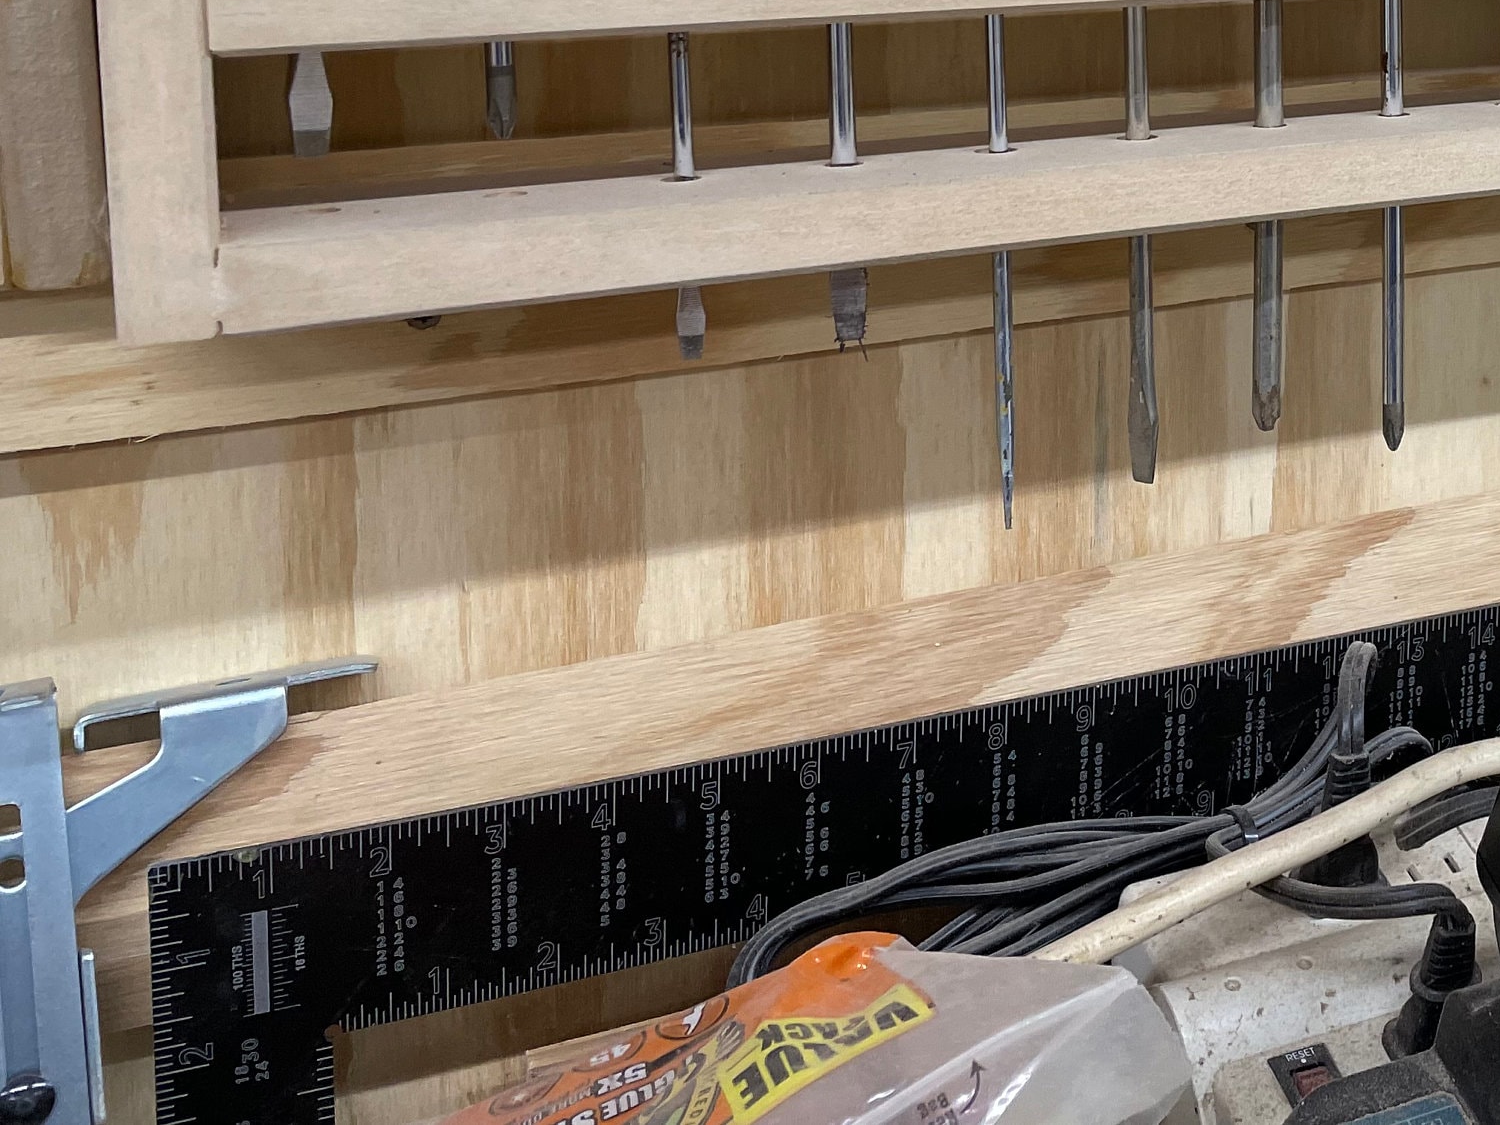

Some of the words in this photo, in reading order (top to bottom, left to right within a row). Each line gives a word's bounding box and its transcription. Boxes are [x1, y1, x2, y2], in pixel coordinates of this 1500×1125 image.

[1468, 622, 1495, 649] 14
[1397, 636, 1425, 664] 13
[1245, 667, 1273, 696] 11
[1164, 683, 1197, 712] 10
[1076, 705, 1093, 732] 9
[988, 723, 1004, 750] 8
[896, 741, 914, 769] 7
[800, 761, 817, 789] 6
[700, 781, 718, 810] 5
[591, 803, 611, 831] 4
[484, 824, 503, 855] 3
[369, 846, 390, 877] 2
[252, 869, 265, 899] 1
[746, 893, 764, 920] 4
[643, 916, 662, 946] 3
[176, 948, 211, 964] 1
[537, 941, 556, 971] 2
[428, 966, 440, 994] 1
[179, 1042, 214, 1065] 2
[1285, 1045, 1316, 1063] RESET
[597, 1062, 648, 1095] 5X
[602, 1069, 676, 1121] GLUE
